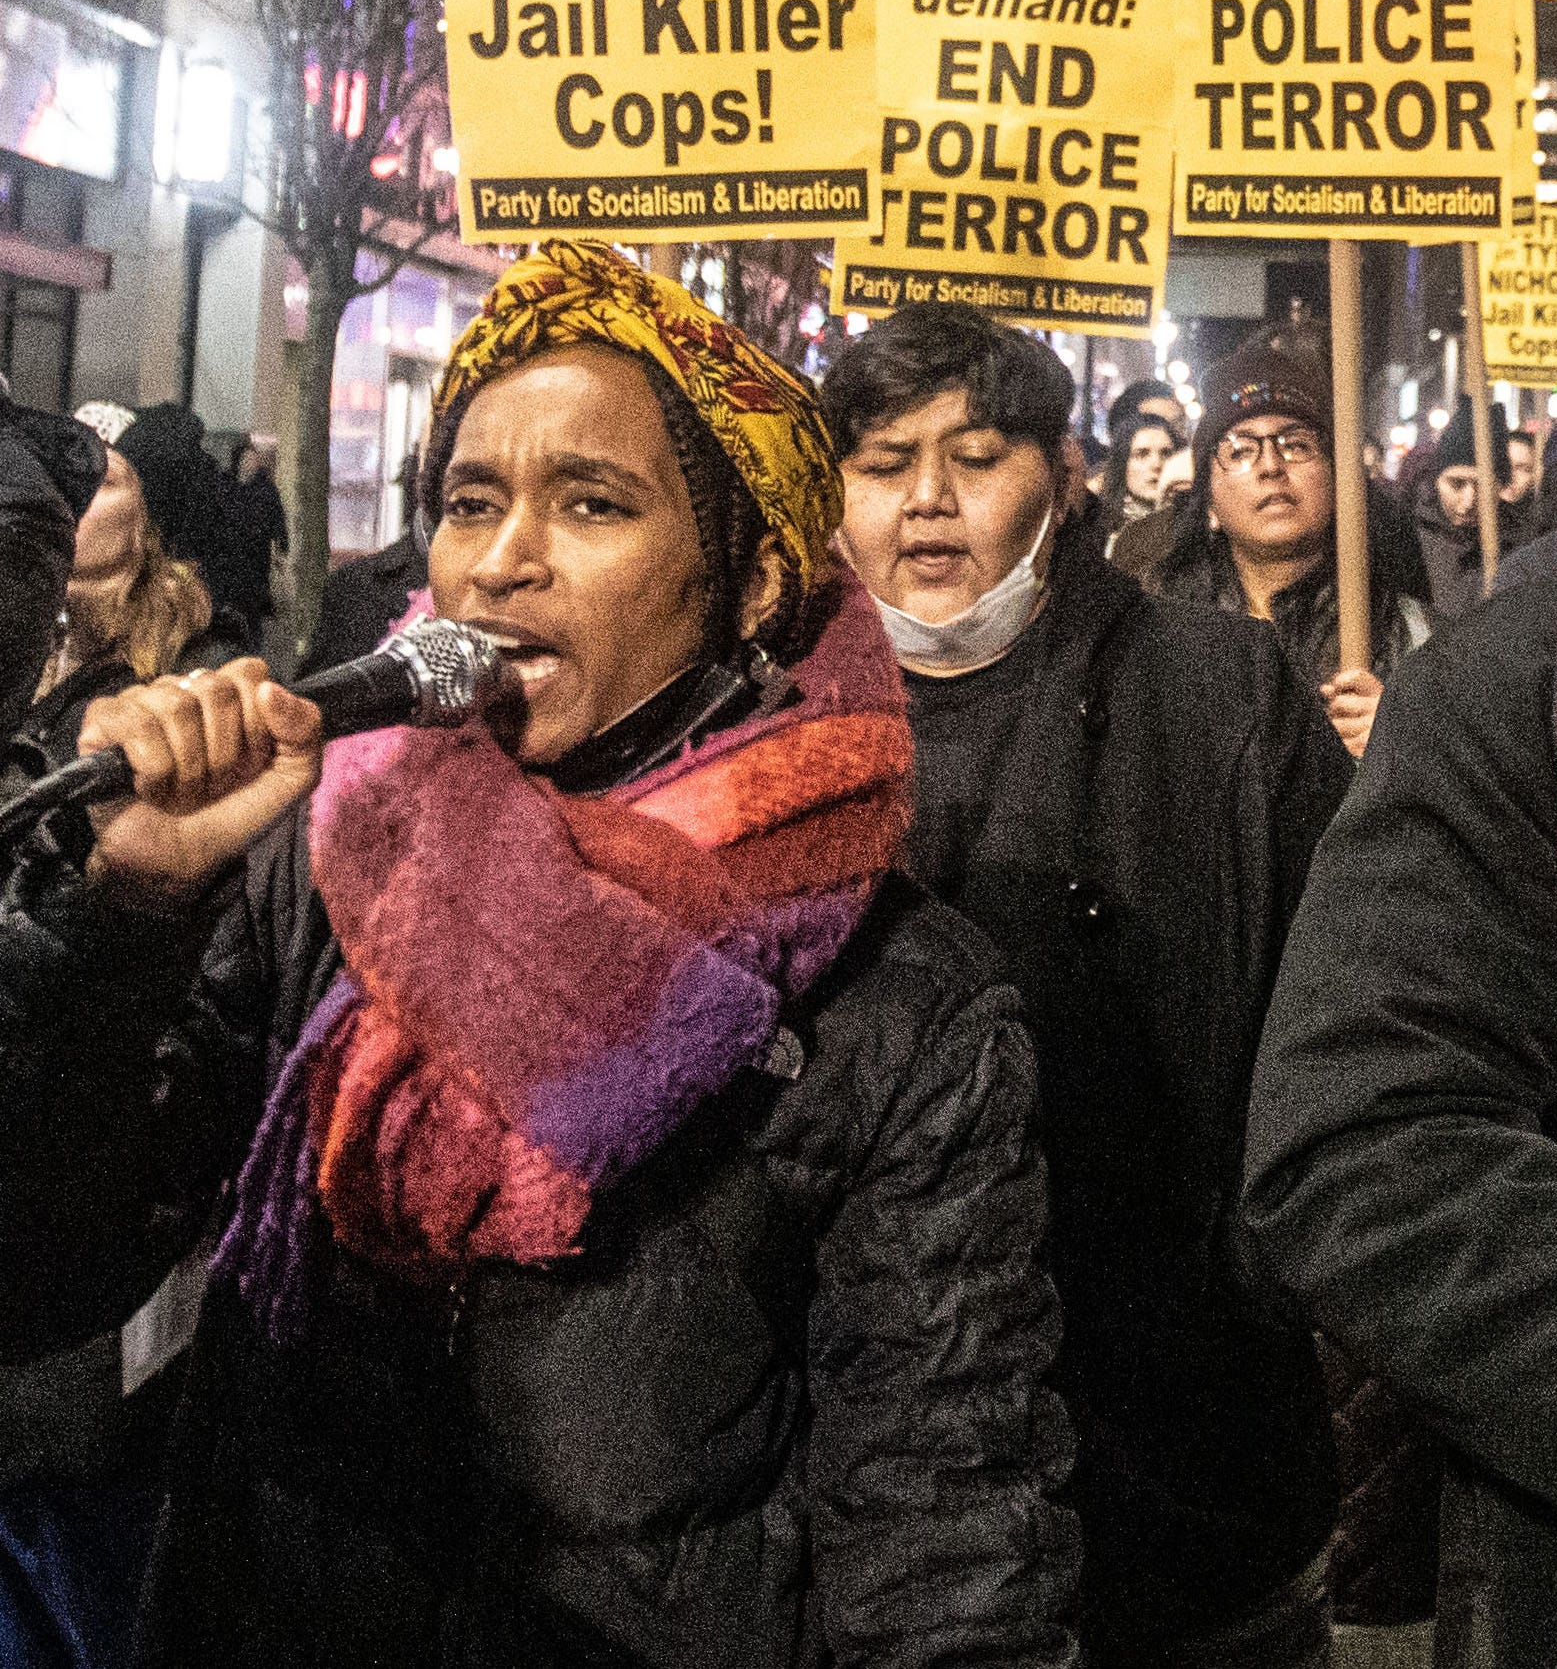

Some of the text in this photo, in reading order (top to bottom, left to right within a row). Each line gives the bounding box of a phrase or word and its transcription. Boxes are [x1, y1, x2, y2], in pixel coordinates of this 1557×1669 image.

[937, 39, 1095, 108] END
[555, 69, 774, 166] Cops!
[1194, 79, 1495, 152] TERROR
[880, 117, 1140, 192] POLICE
[480, 178, 860, 225] Party for Socialism & Liberation
[1191, 183, 1241, 219] Party
[1246, 184, 1269, 214] for
[1273, 184, 1365, 214] Socialism
[1370, 184, 1387, 214] &
[1391, 185, 1494, 216] Liberation
[850, 273, 900, 305] Party
[905, 277, 933, 302] for
[936, 279, 1027, 307] Socialism
[1052, 286, 1147, 317] Liberation
[1483, 301, 1524, 326] Jail
